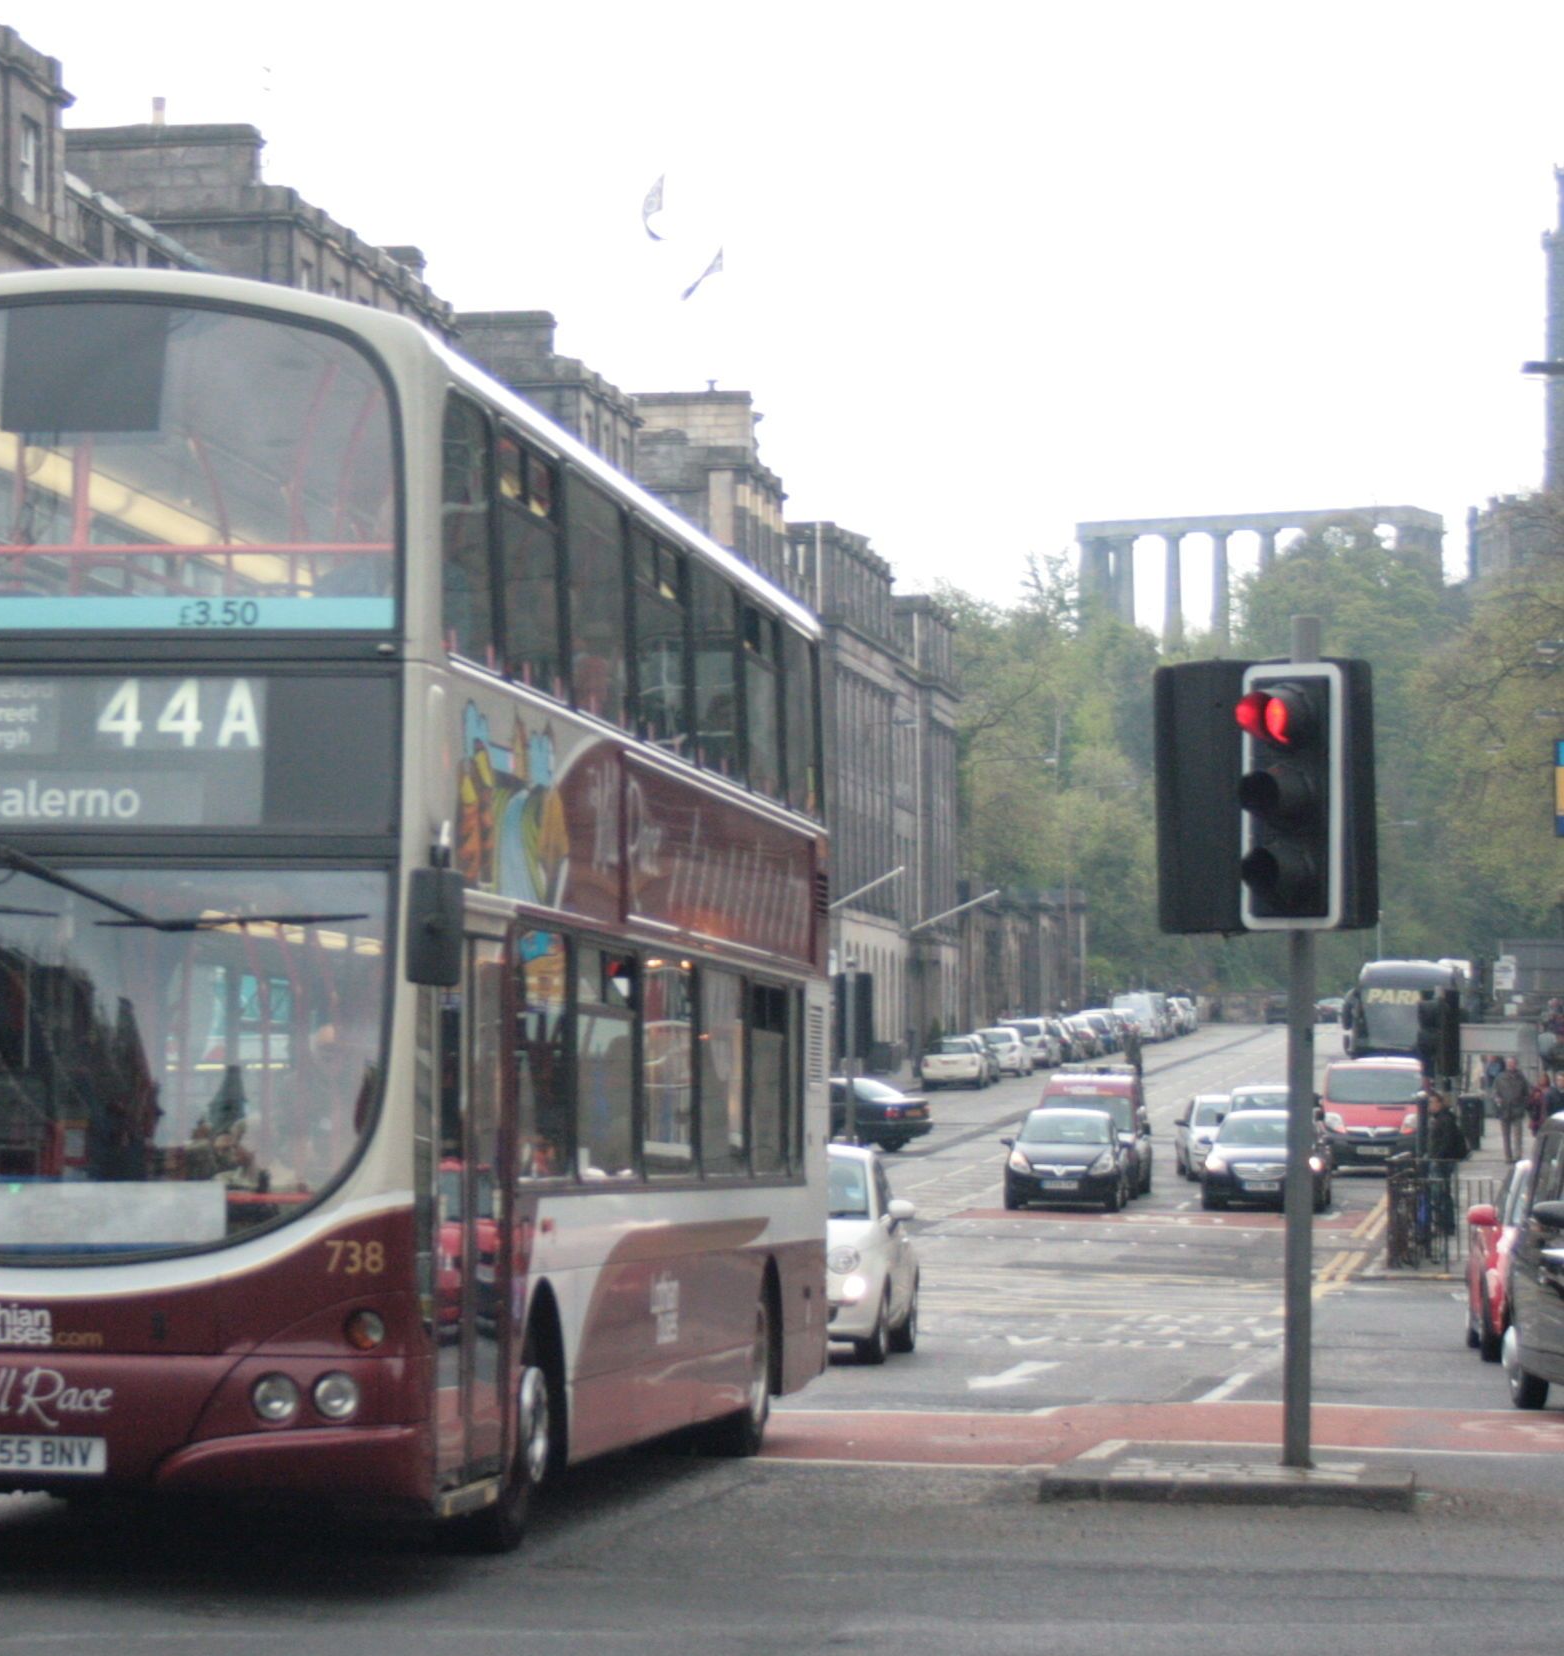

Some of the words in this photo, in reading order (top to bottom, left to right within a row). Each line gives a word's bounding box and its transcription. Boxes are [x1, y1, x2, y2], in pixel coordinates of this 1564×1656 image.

[178, 600, 259, 627] £3.50
[324, 1240, 385, 1274] 738
[17, 1366, 114, 1427] Race
[40, 1440, 93, 1467] BNV
